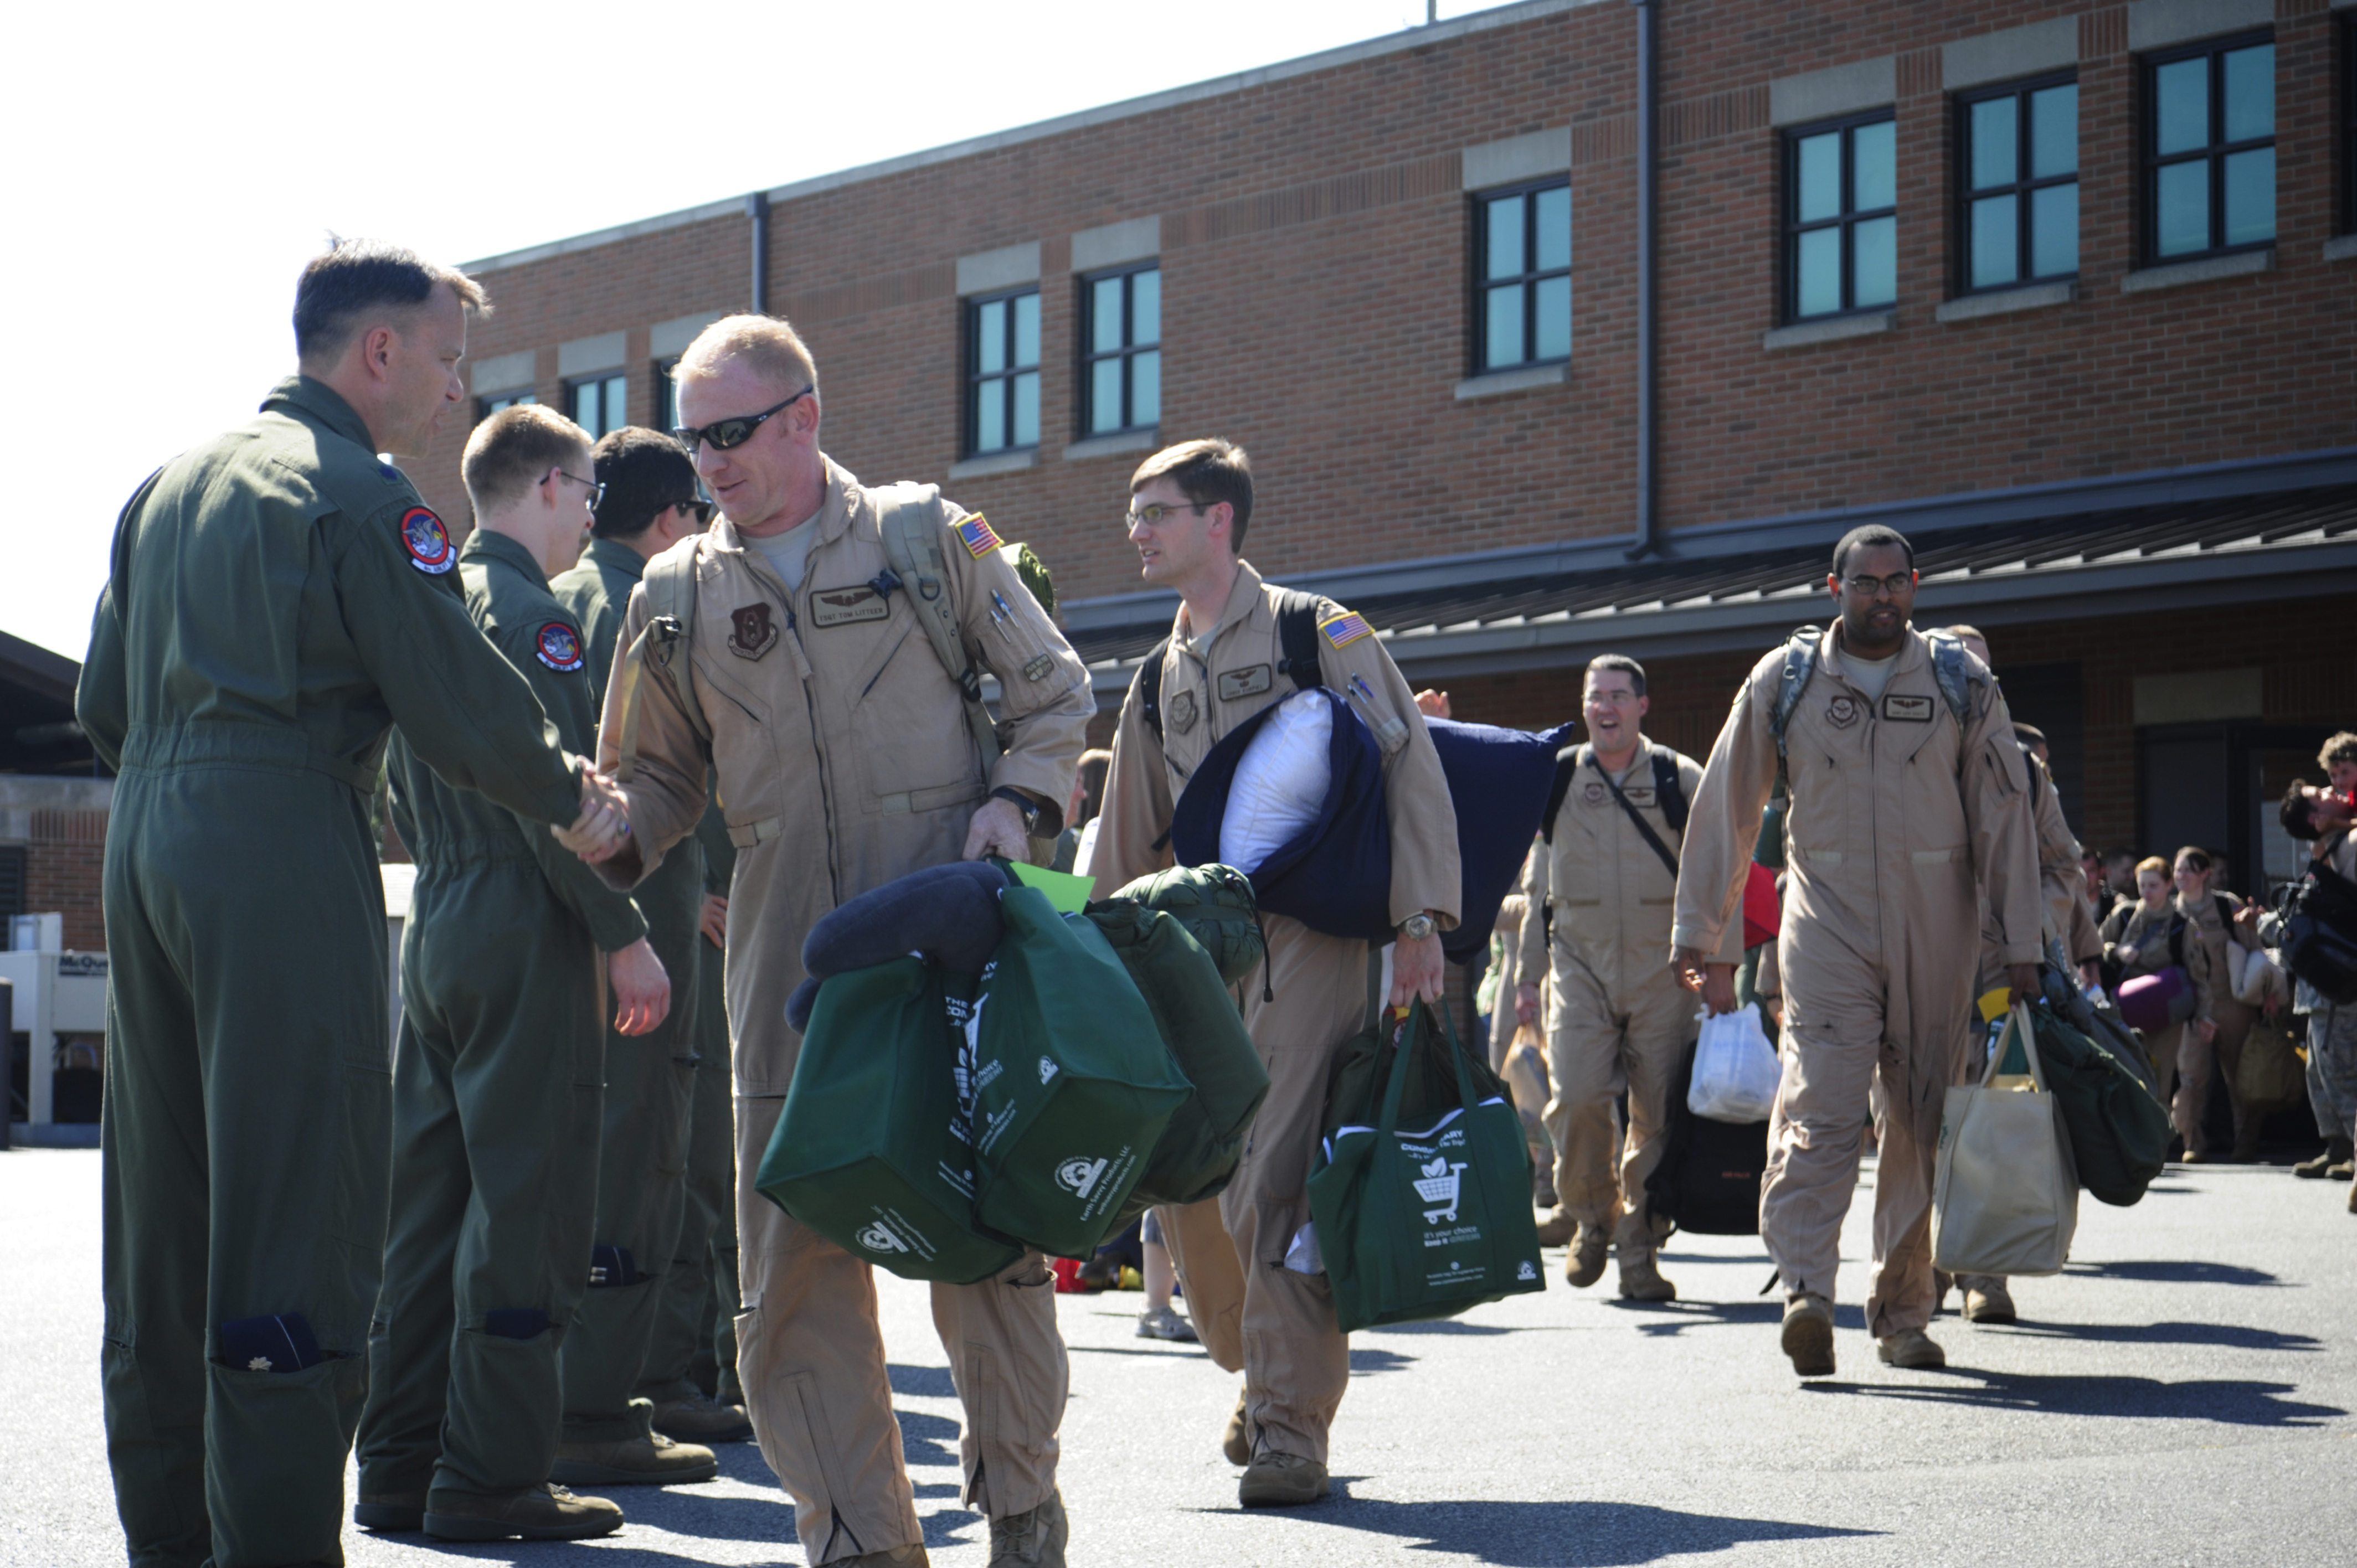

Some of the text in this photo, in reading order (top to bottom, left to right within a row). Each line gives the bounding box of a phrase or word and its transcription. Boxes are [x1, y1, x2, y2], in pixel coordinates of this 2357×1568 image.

[819, 613, 836, 622] TSGT
[945, 996, 969, 1009] THE
[1080, 1203, 1095, 1221] Earth
[1089, 1185, 1107, 1203] Savvy
[1119, 1144, 1131, 1157] LLC
